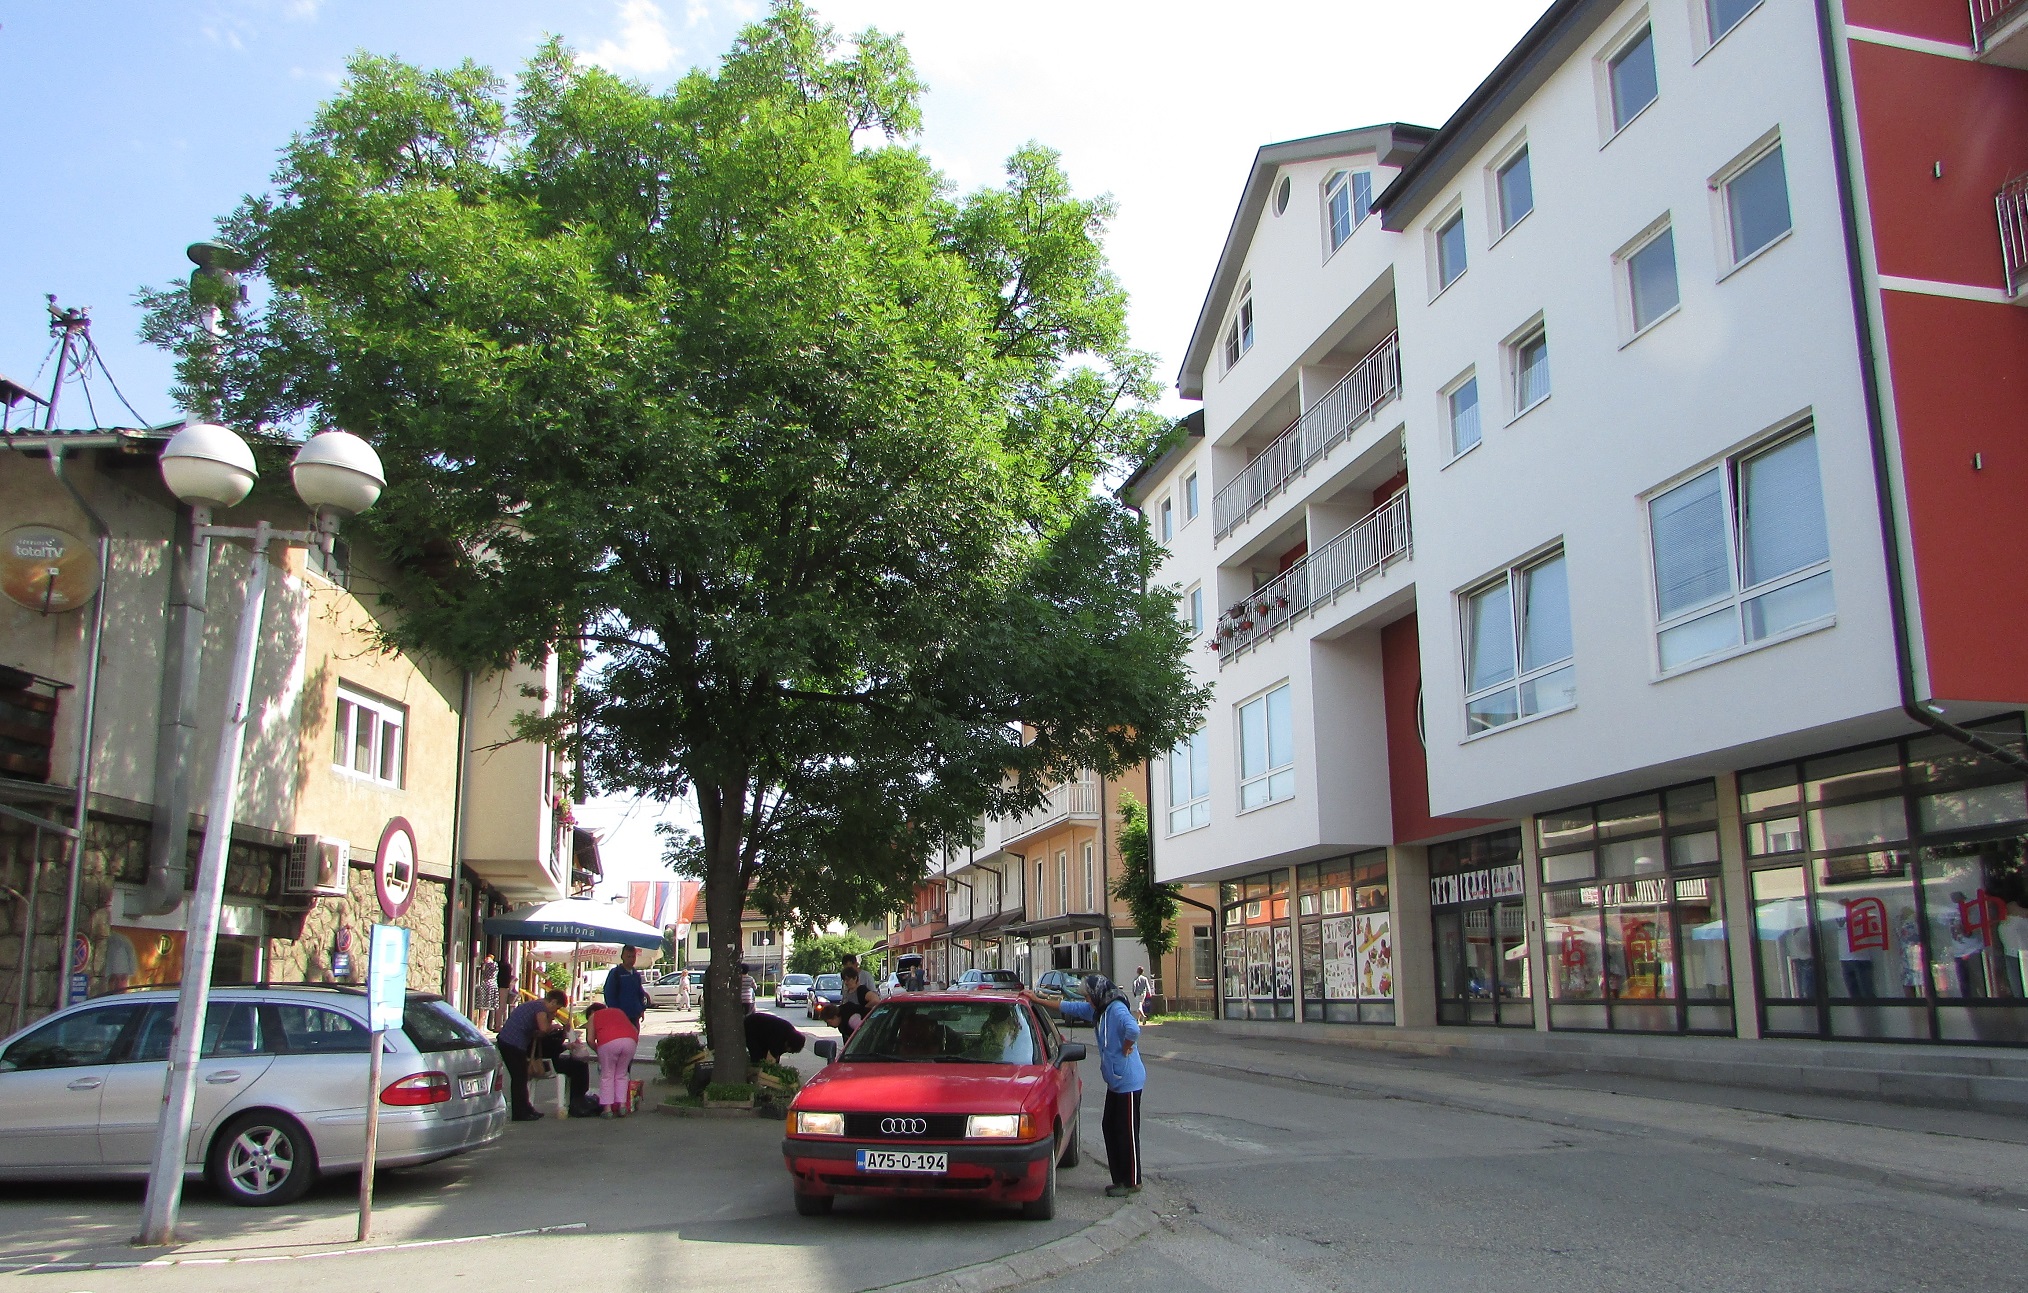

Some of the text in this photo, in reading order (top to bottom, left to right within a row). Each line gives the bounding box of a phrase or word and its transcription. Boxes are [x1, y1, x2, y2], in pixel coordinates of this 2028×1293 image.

[543, 924, 595, 937] Fruktona
[1845, 897, 1889, 952] 国
[1958, 888, 2008, 946] 中
